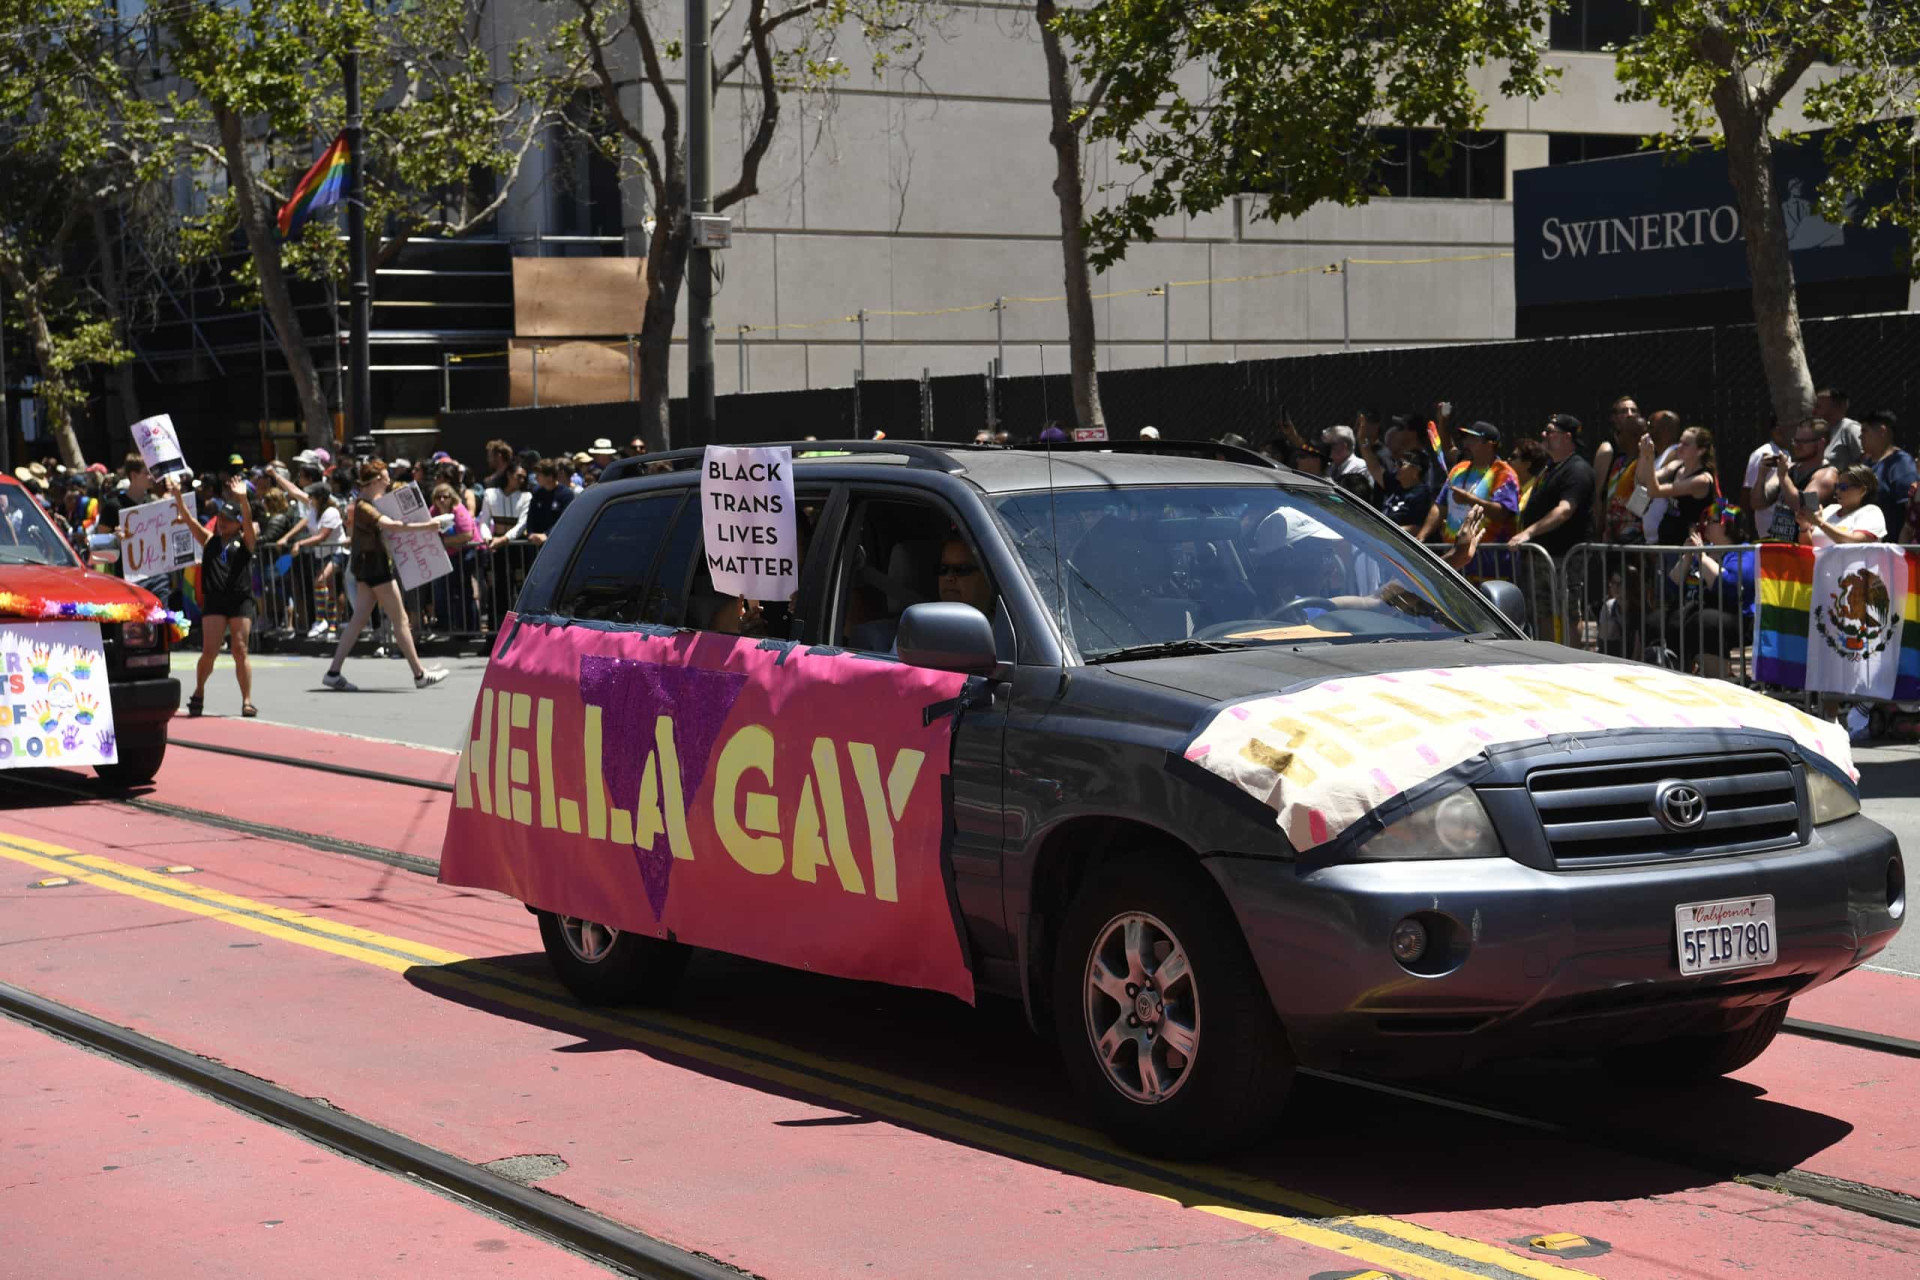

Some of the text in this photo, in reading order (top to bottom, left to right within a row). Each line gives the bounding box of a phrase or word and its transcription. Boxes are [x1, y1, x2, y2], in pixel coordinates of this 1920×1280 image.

[1541, 205, 1745, 260] SWINERTO
[709, 461, 782, 482] BLACK
[710, 492, 783, 513] TRANS
[718, 523, 778, 545] LIVES
[708, 552, 793, 576] MATTER
[456, 688, 925, 902] HELLA GAY
[1696, 905, 1756, 925] California
[1684, 922, 1769, 963] 5FIB780
